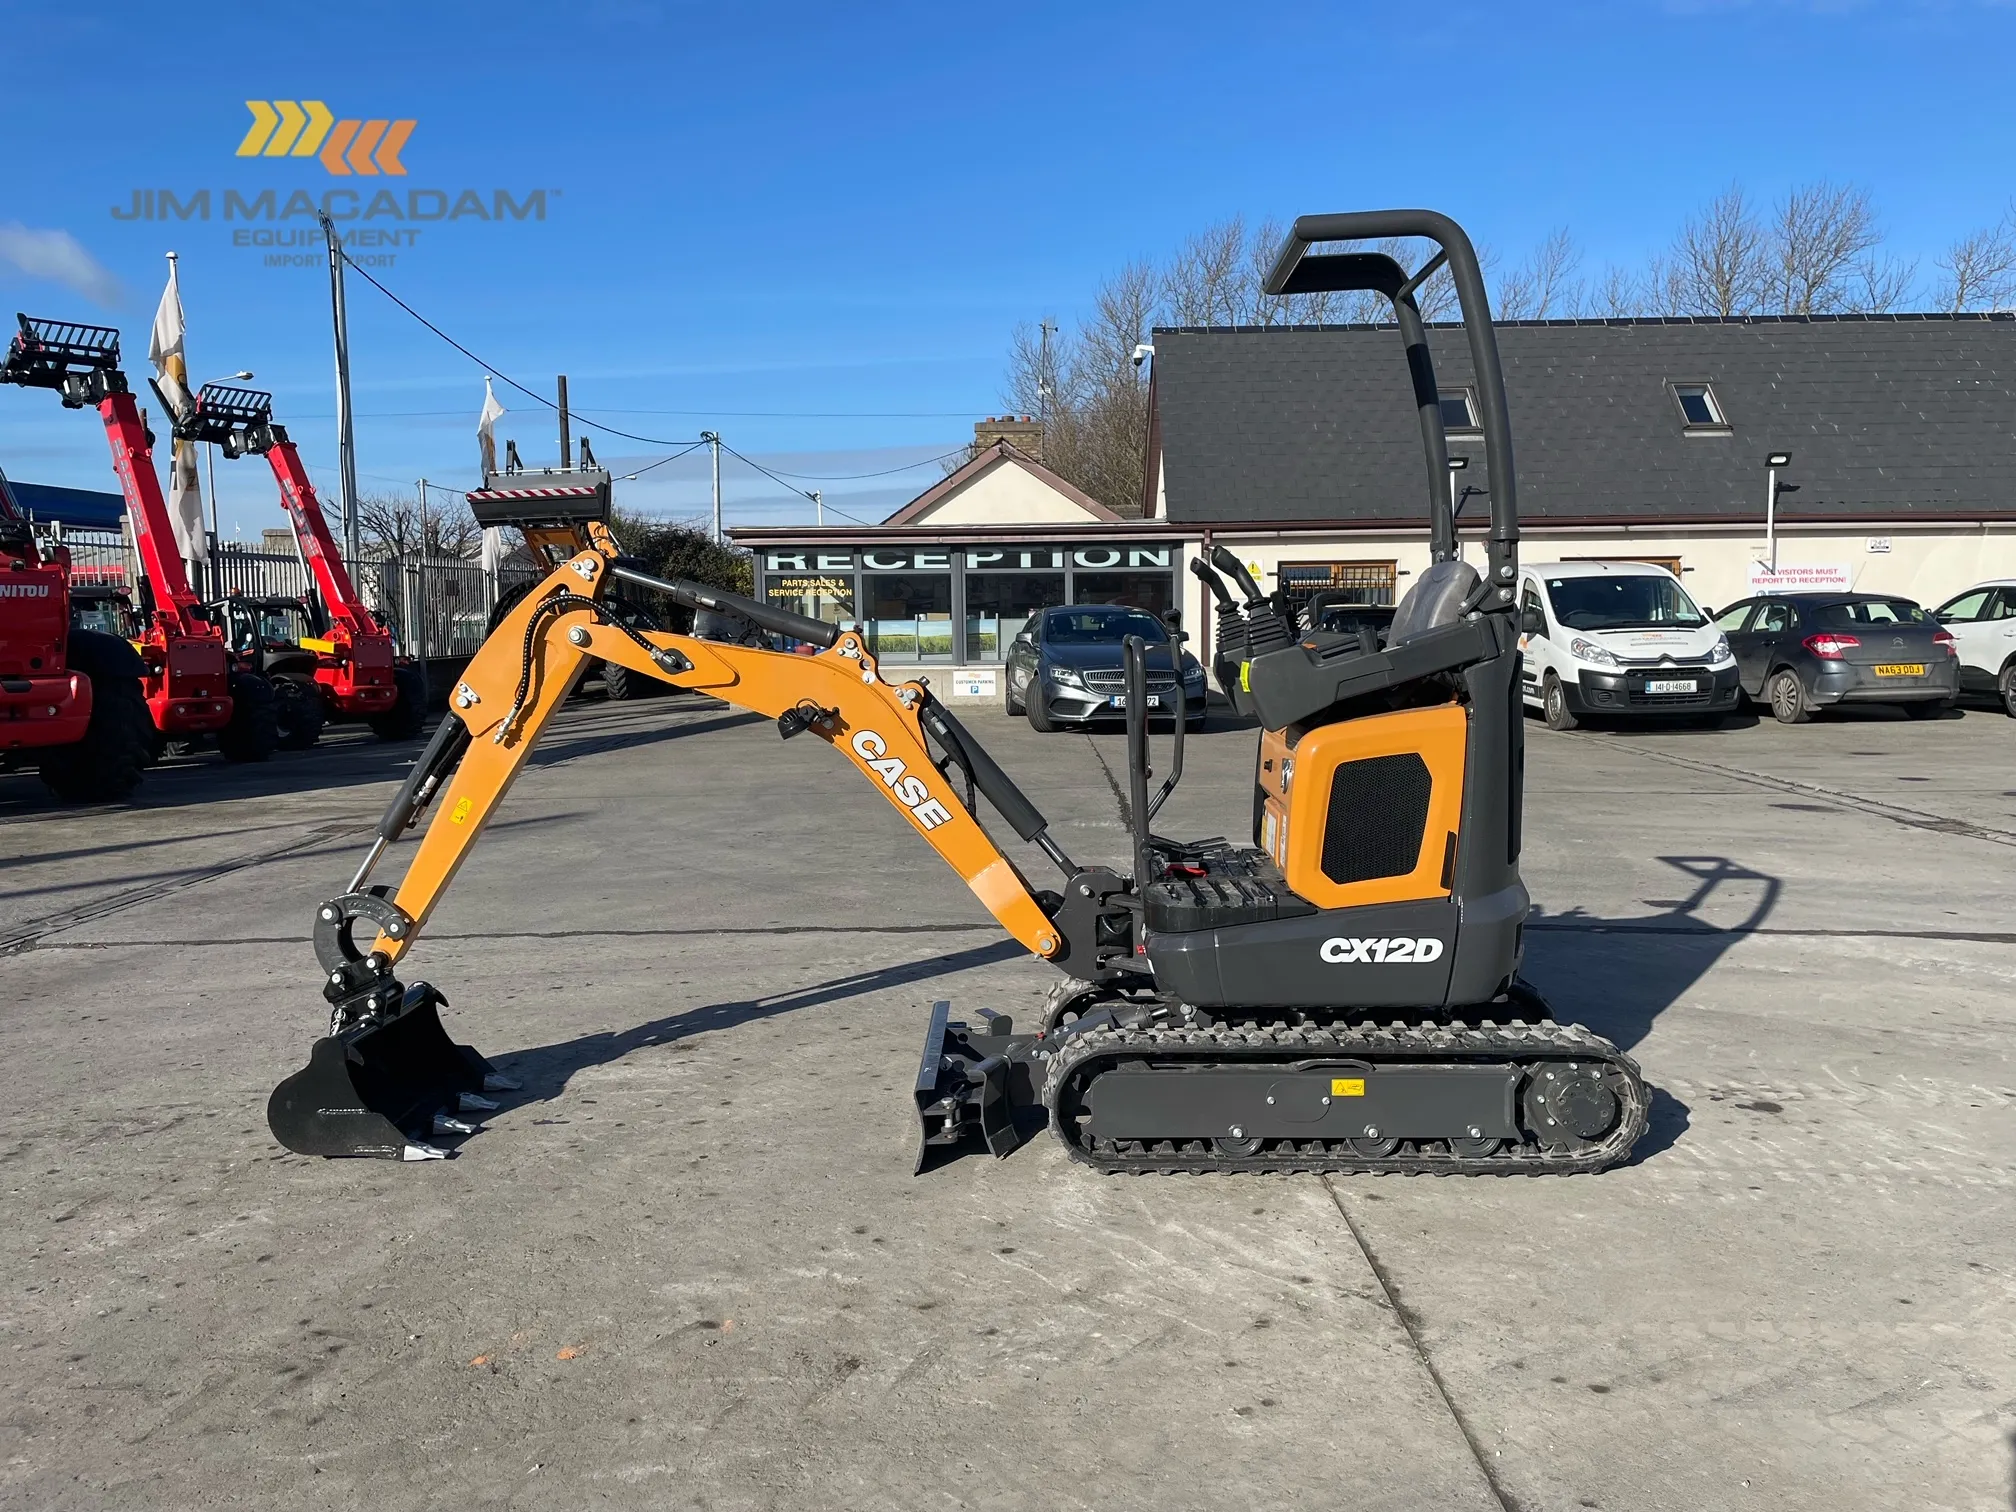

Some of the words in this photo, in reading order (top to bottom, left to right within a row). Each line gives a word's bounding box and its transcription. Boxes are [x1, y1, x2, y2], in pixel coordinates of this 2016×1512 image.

[767, 546, 1170, 570] RECEPTION
[768, 588, 804, 597] SERVICE
[805, 588, 853, 597] RECEPTION
[1878, 665, 1902, 675] NA63
[851, 729, 954, 831] CASE
[1319, 937, 1444, 963] CX12D
